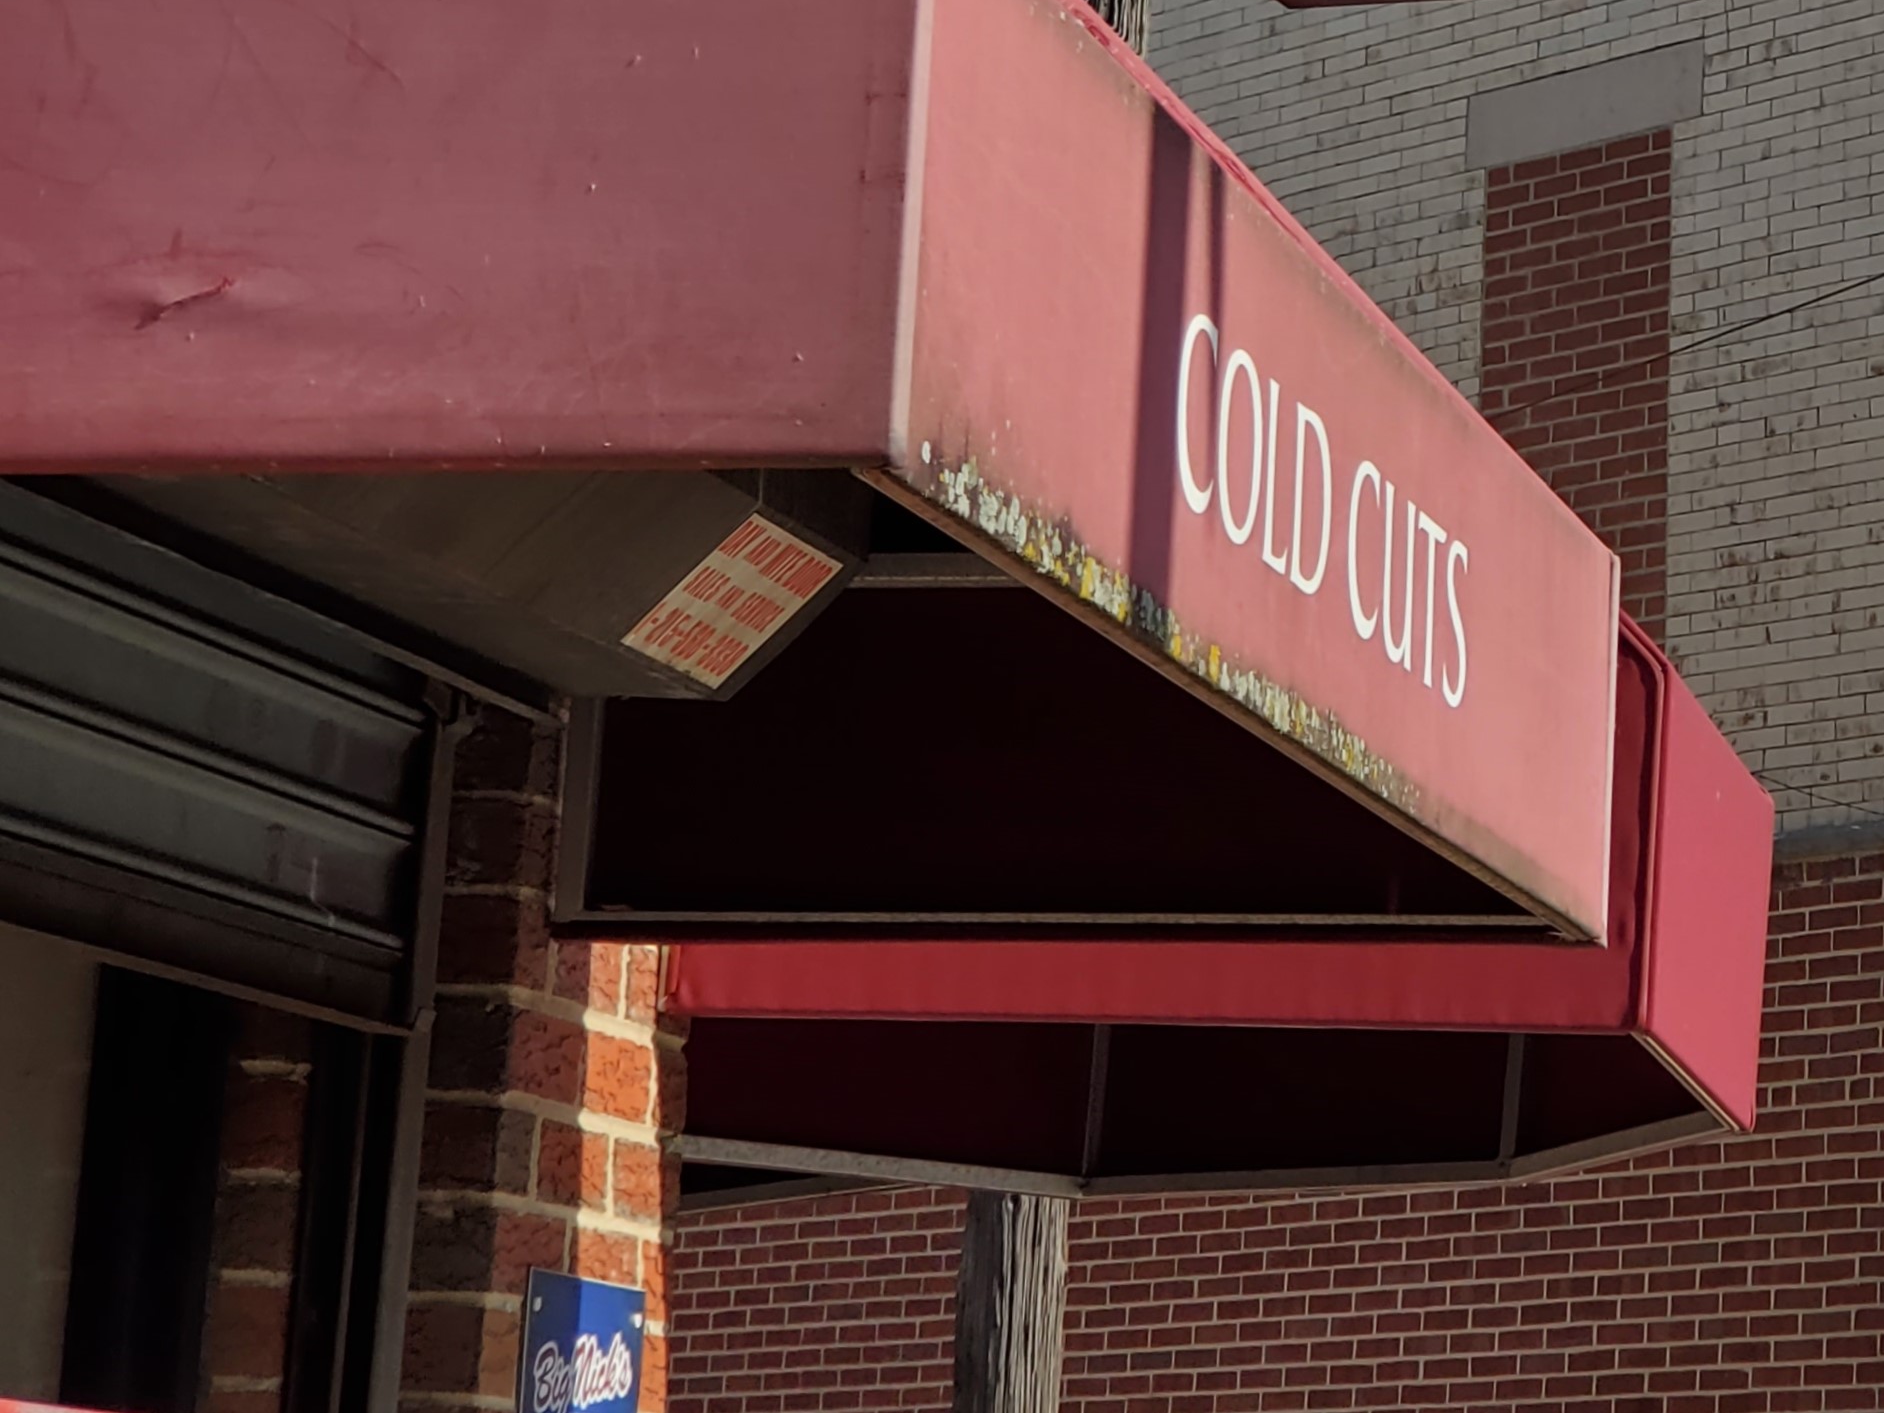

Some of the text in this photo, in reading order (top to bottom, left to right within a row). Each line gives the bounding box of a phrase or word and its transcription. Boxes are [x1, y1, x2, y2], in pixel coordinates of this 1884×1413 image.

[1177, 314, 1468, 708] COLD CUTS
[683, 564, 731, 601] SALES
[533, 1341, 573, 1412] Big
